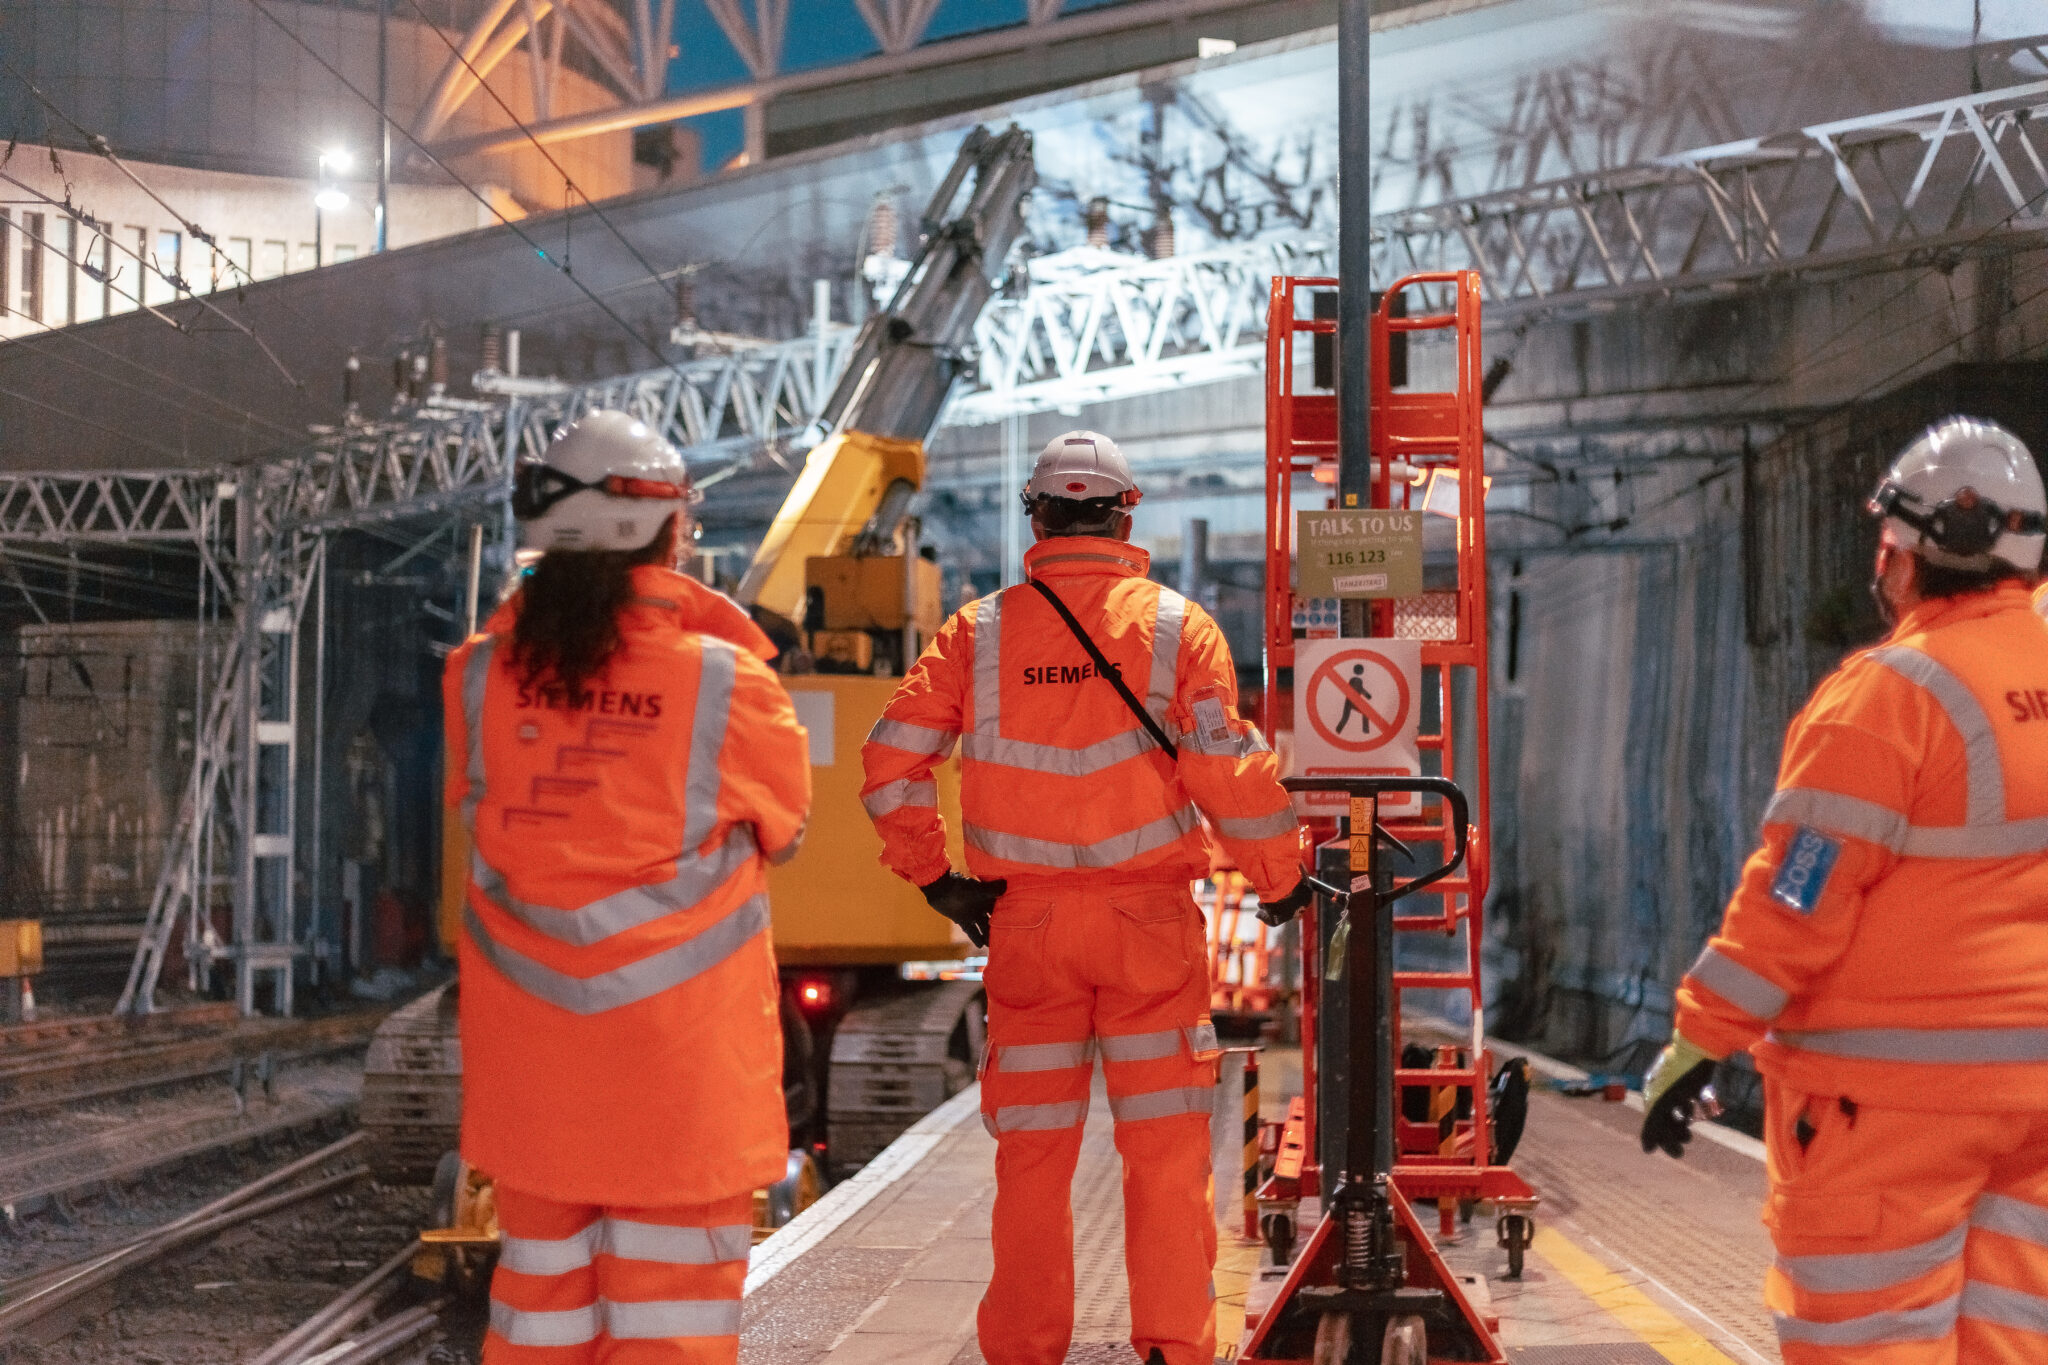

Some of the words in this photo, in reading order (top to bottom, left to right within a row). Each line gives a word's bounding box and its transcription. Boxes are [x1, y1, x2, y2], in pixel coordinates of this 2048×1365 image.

[1308, 517, 1354, 536] TALK
[1358, 517, 1385, 534] TO
[1389, 515, 1413, 532] US
[1328, 551, 1354, 565] 116
[1359, 550, 1385, 563] 123
